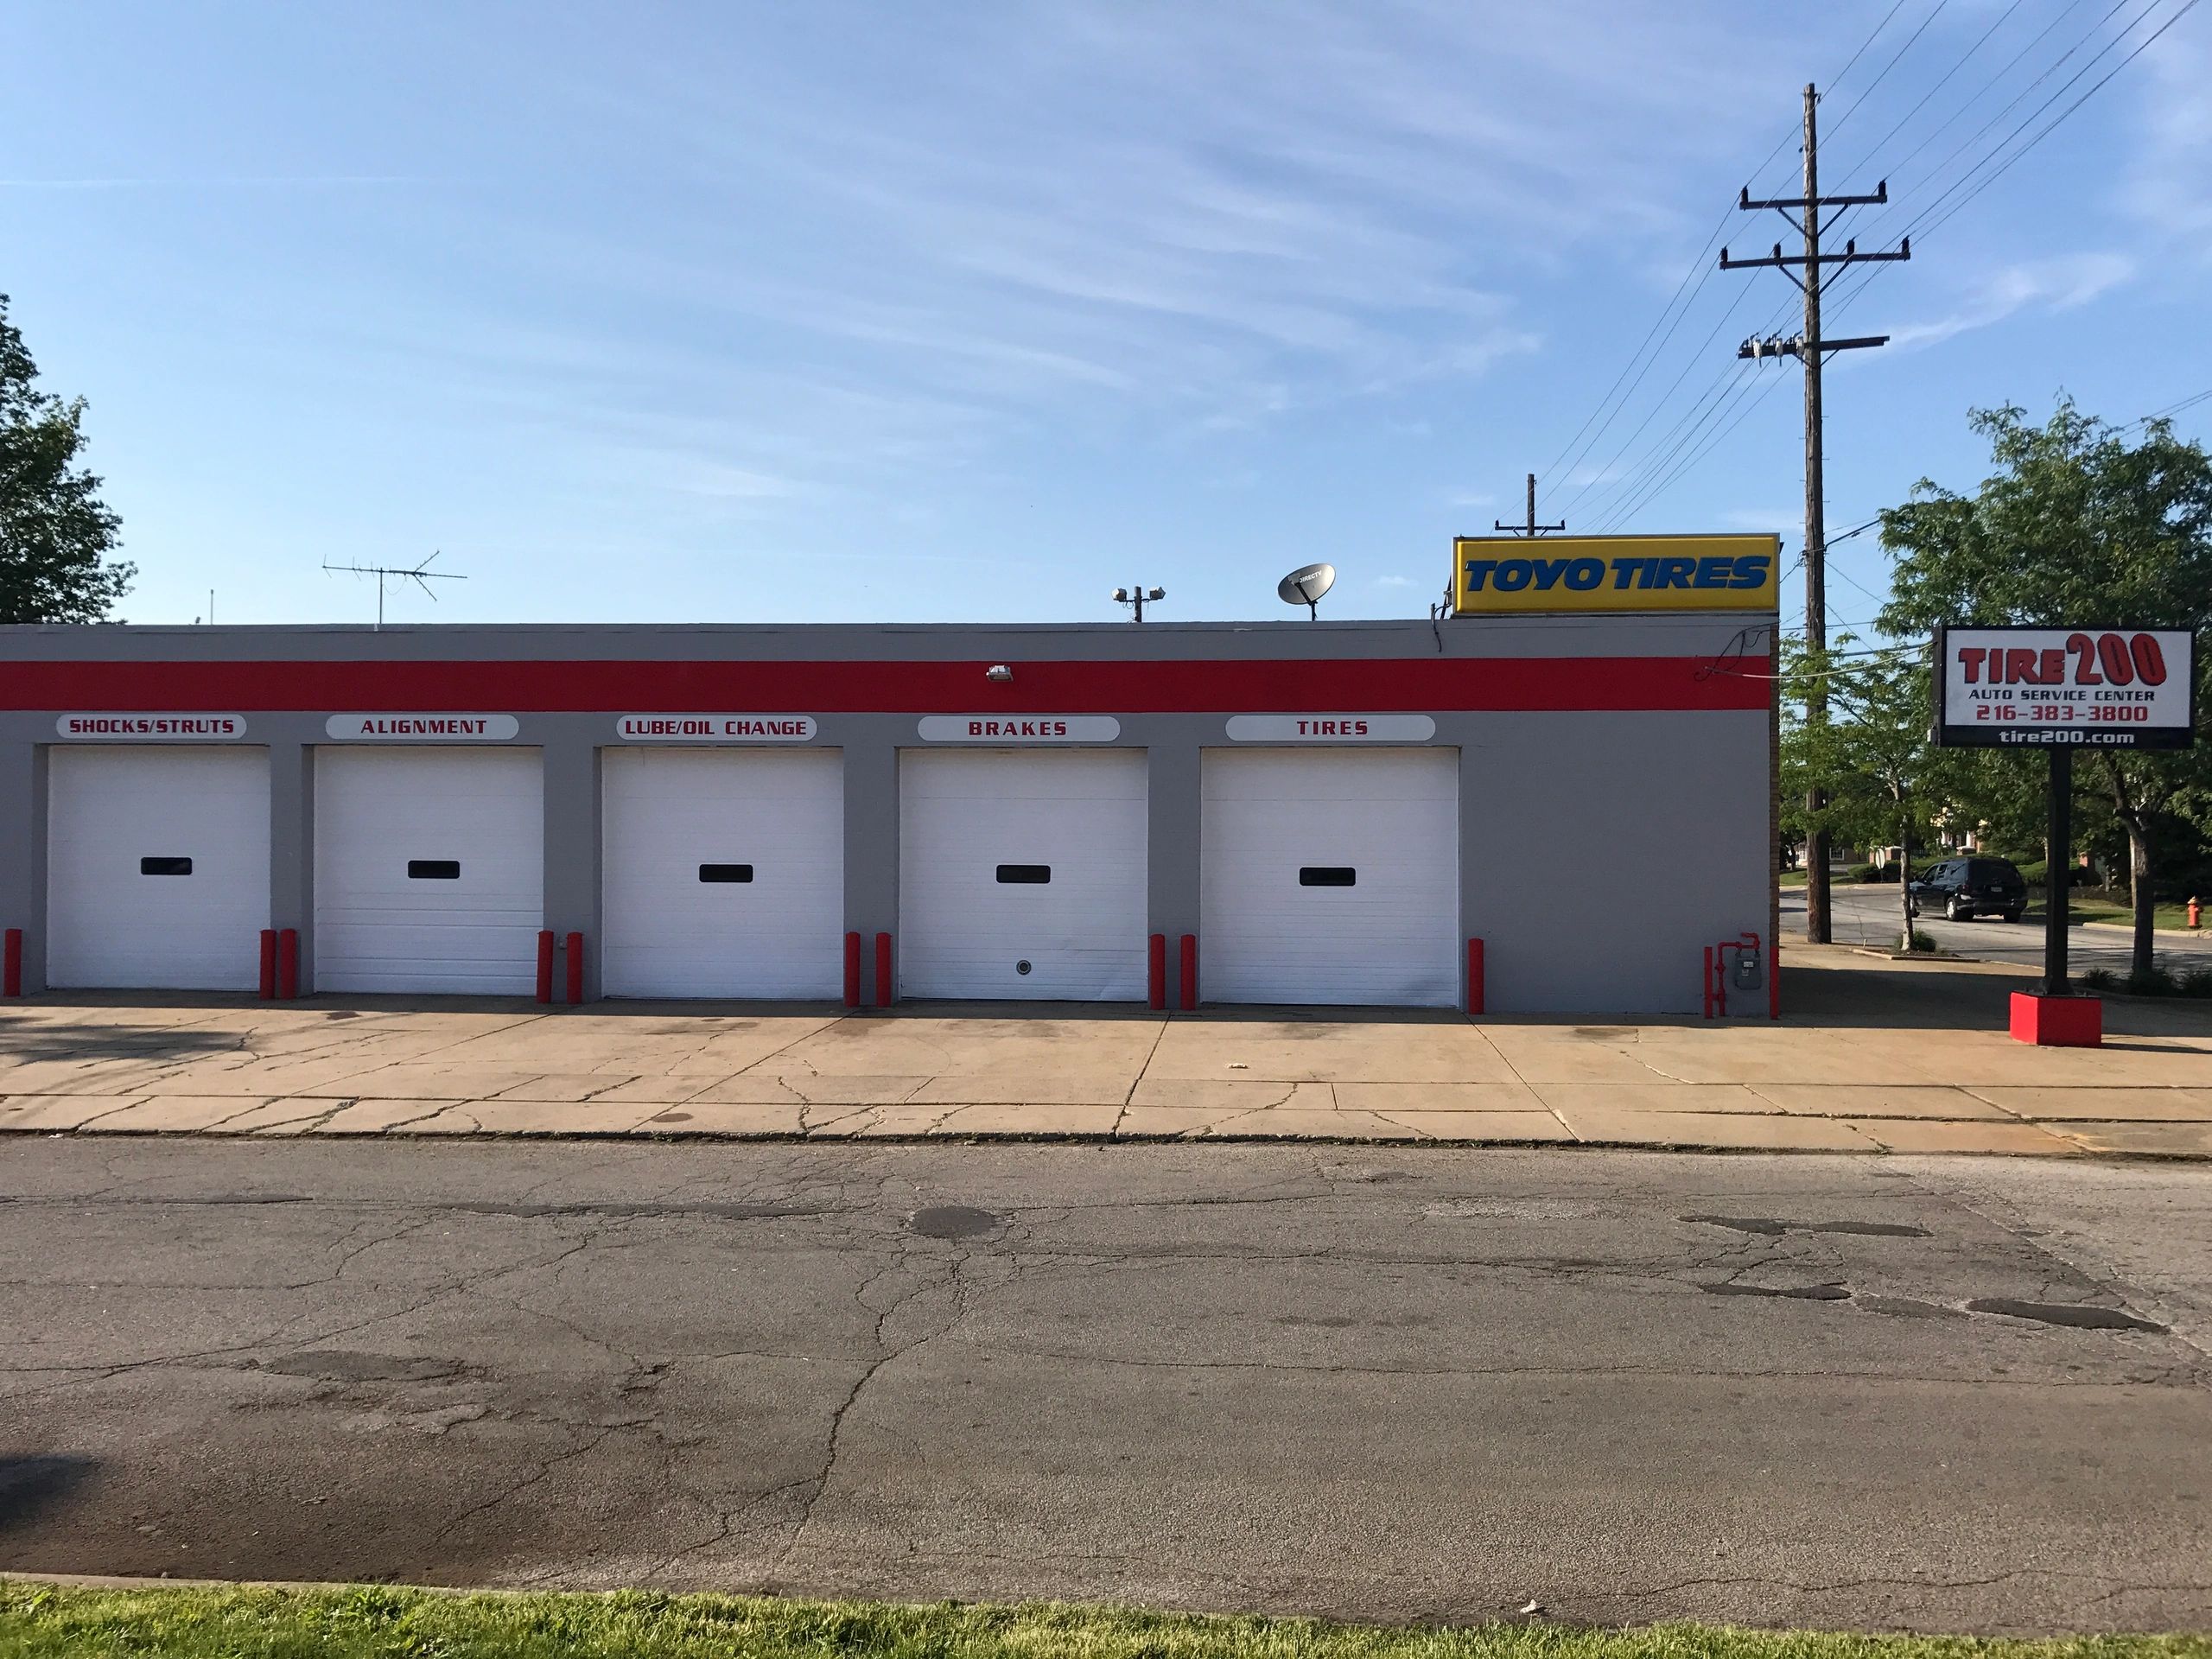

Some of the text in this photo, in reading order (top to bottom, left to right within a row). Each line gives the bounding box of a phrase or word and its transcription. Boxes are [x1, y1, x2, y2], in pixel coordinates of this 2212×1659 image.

[1465, 556, 1771, 591] TOYO TIRES
[1968, 690, 2155, 702] AUTO SERVICE CENTER
[1976, 704, 2148, 721] 216-383-3800
[69, 719, 235, 734] SHOCKS/STRUTS
[360, 720, 486, 734] ALIGNMENT
[624, 720, 807, 735] LUBE/OIL CHANGE
[969, 721, 1067, 736] BRAKES
[1296, 721, 1369, 735] TIRES
[1999, 730, 2135, 744] tire200.com
